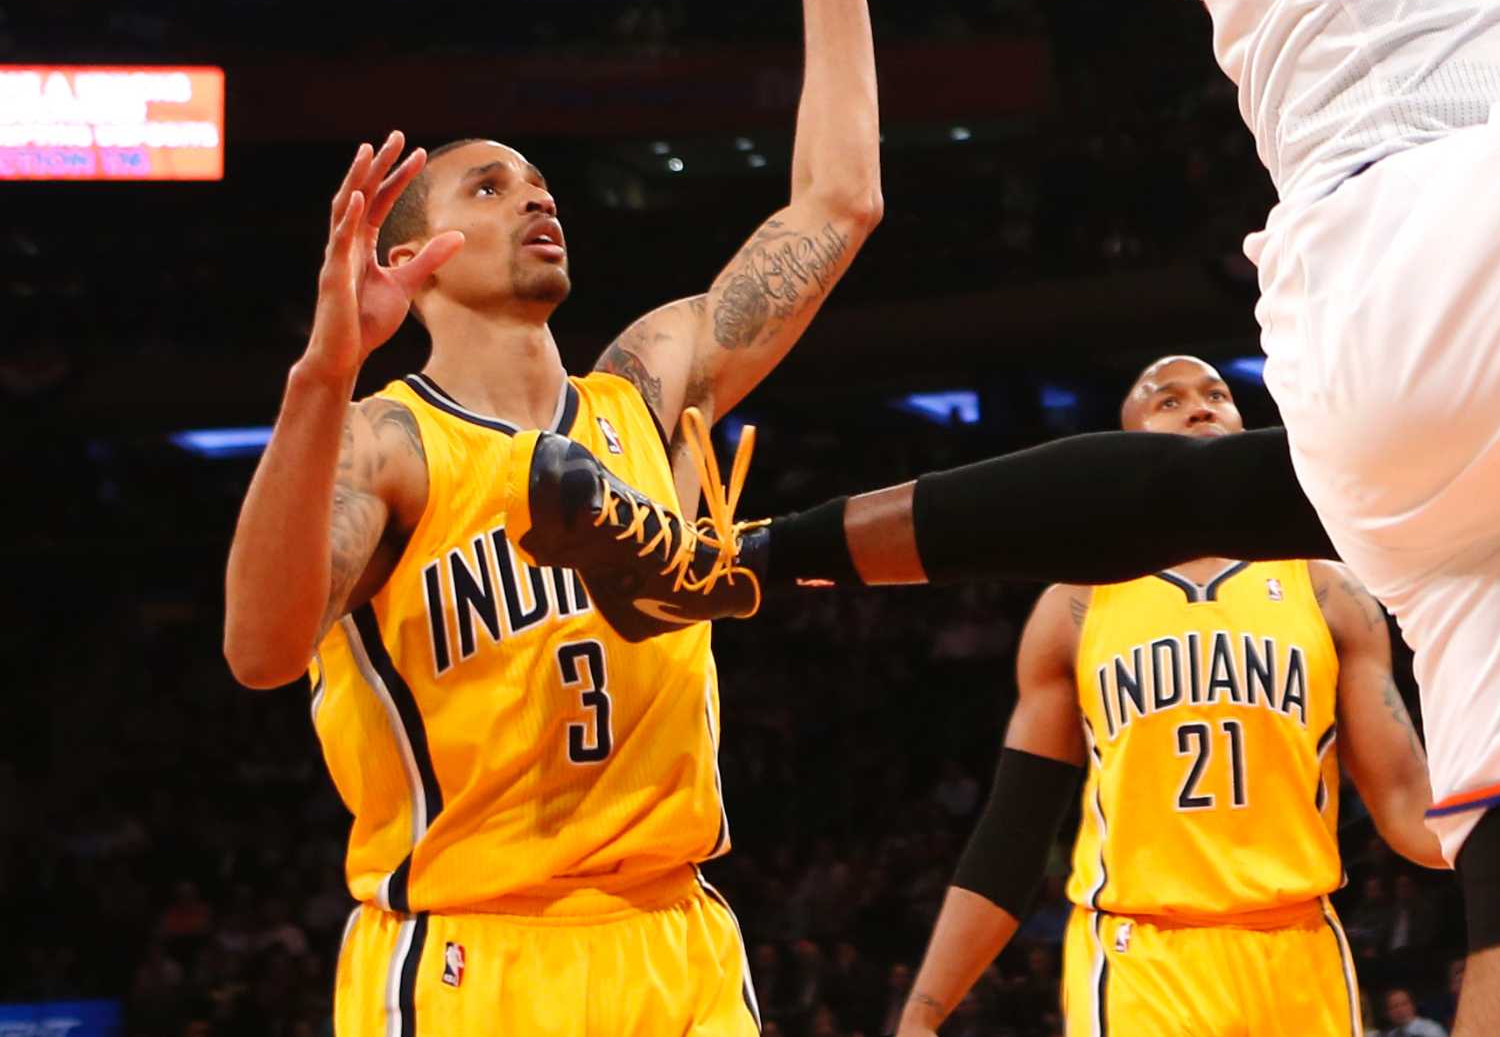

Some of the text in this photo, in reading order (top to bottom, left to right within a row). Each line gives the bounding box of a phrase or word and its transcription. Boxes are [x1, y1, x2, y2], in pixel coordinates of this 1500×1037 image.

[556, 637, 614, 766] 3
[1097, 630, 1309, 742] INDIANA
[1174, 718, 1248, 811] 21
